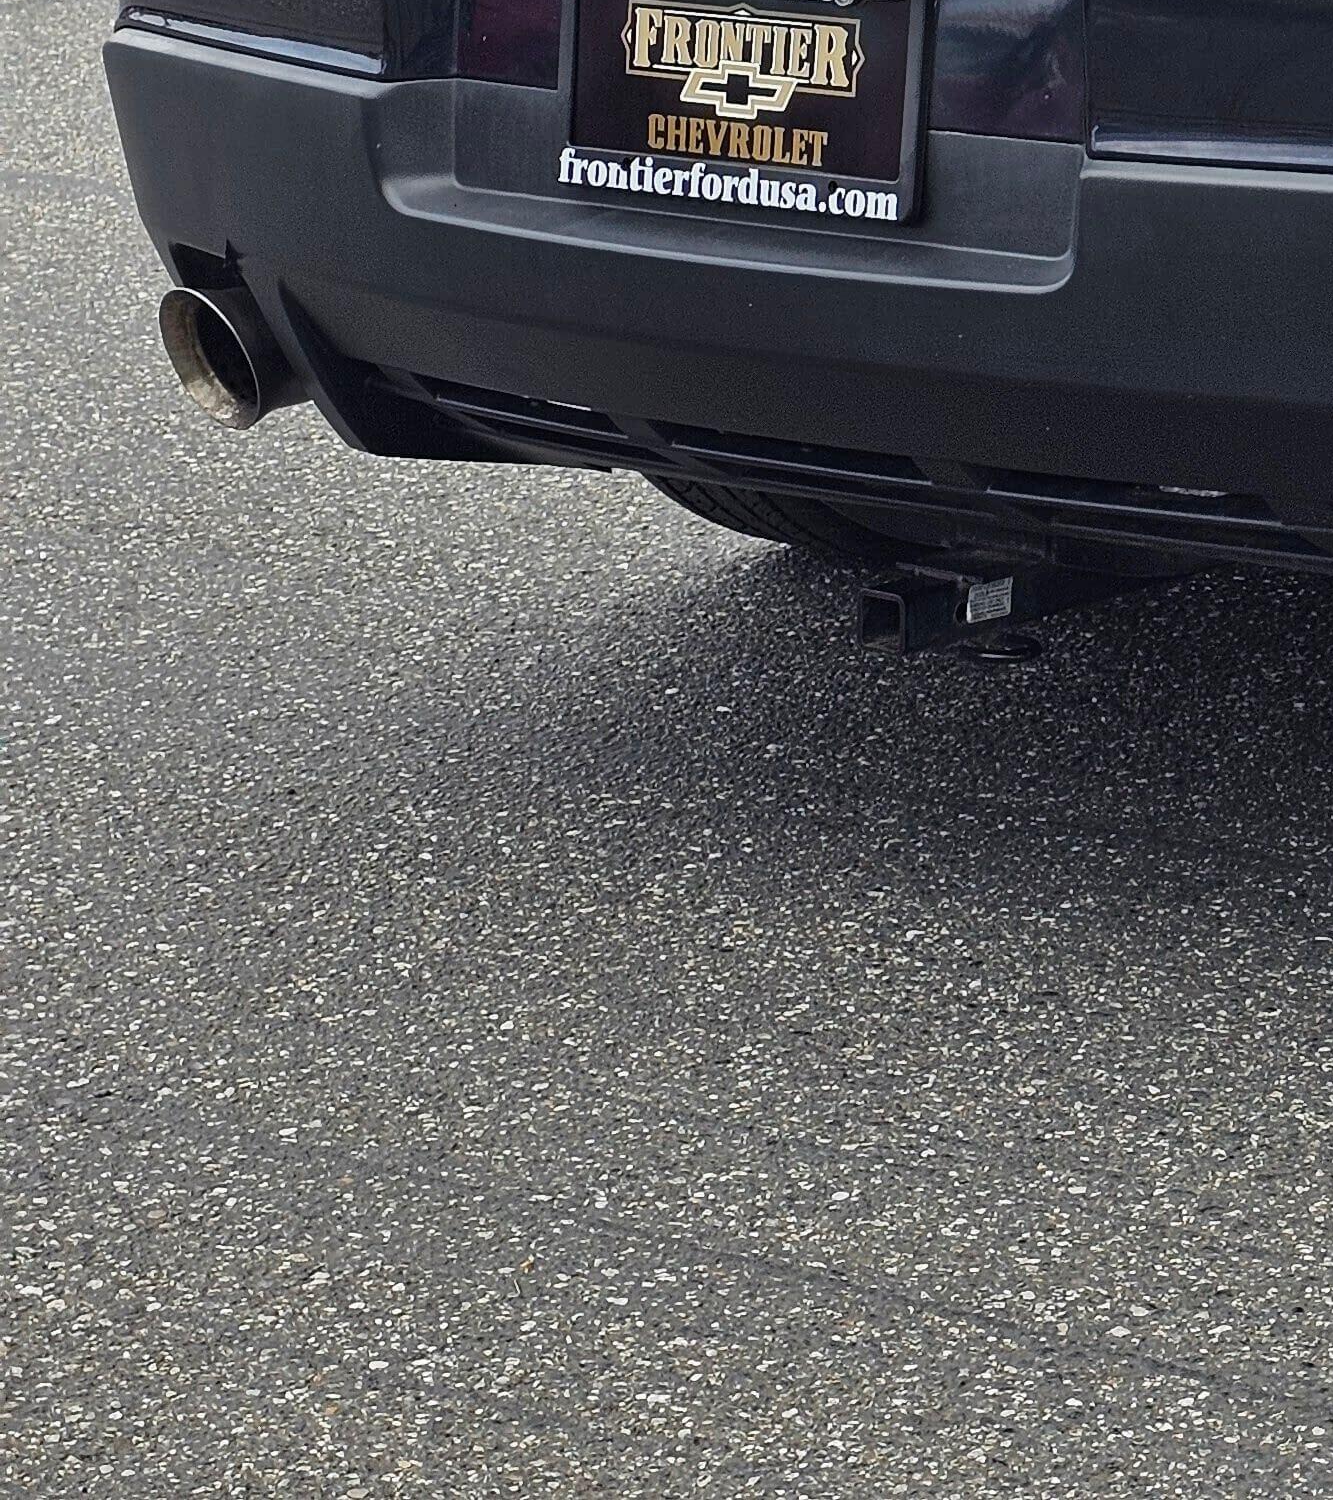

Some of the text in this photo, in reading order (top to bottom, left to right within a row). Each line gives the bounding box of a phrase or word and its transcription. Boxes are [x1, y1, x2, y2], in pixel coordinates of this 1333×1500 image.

[631, 6, 850, 89] FRONTIER
[646, 113, 829, 168] CHEVROLET
[557, 148, 899, 222] frontierfordusa.com
